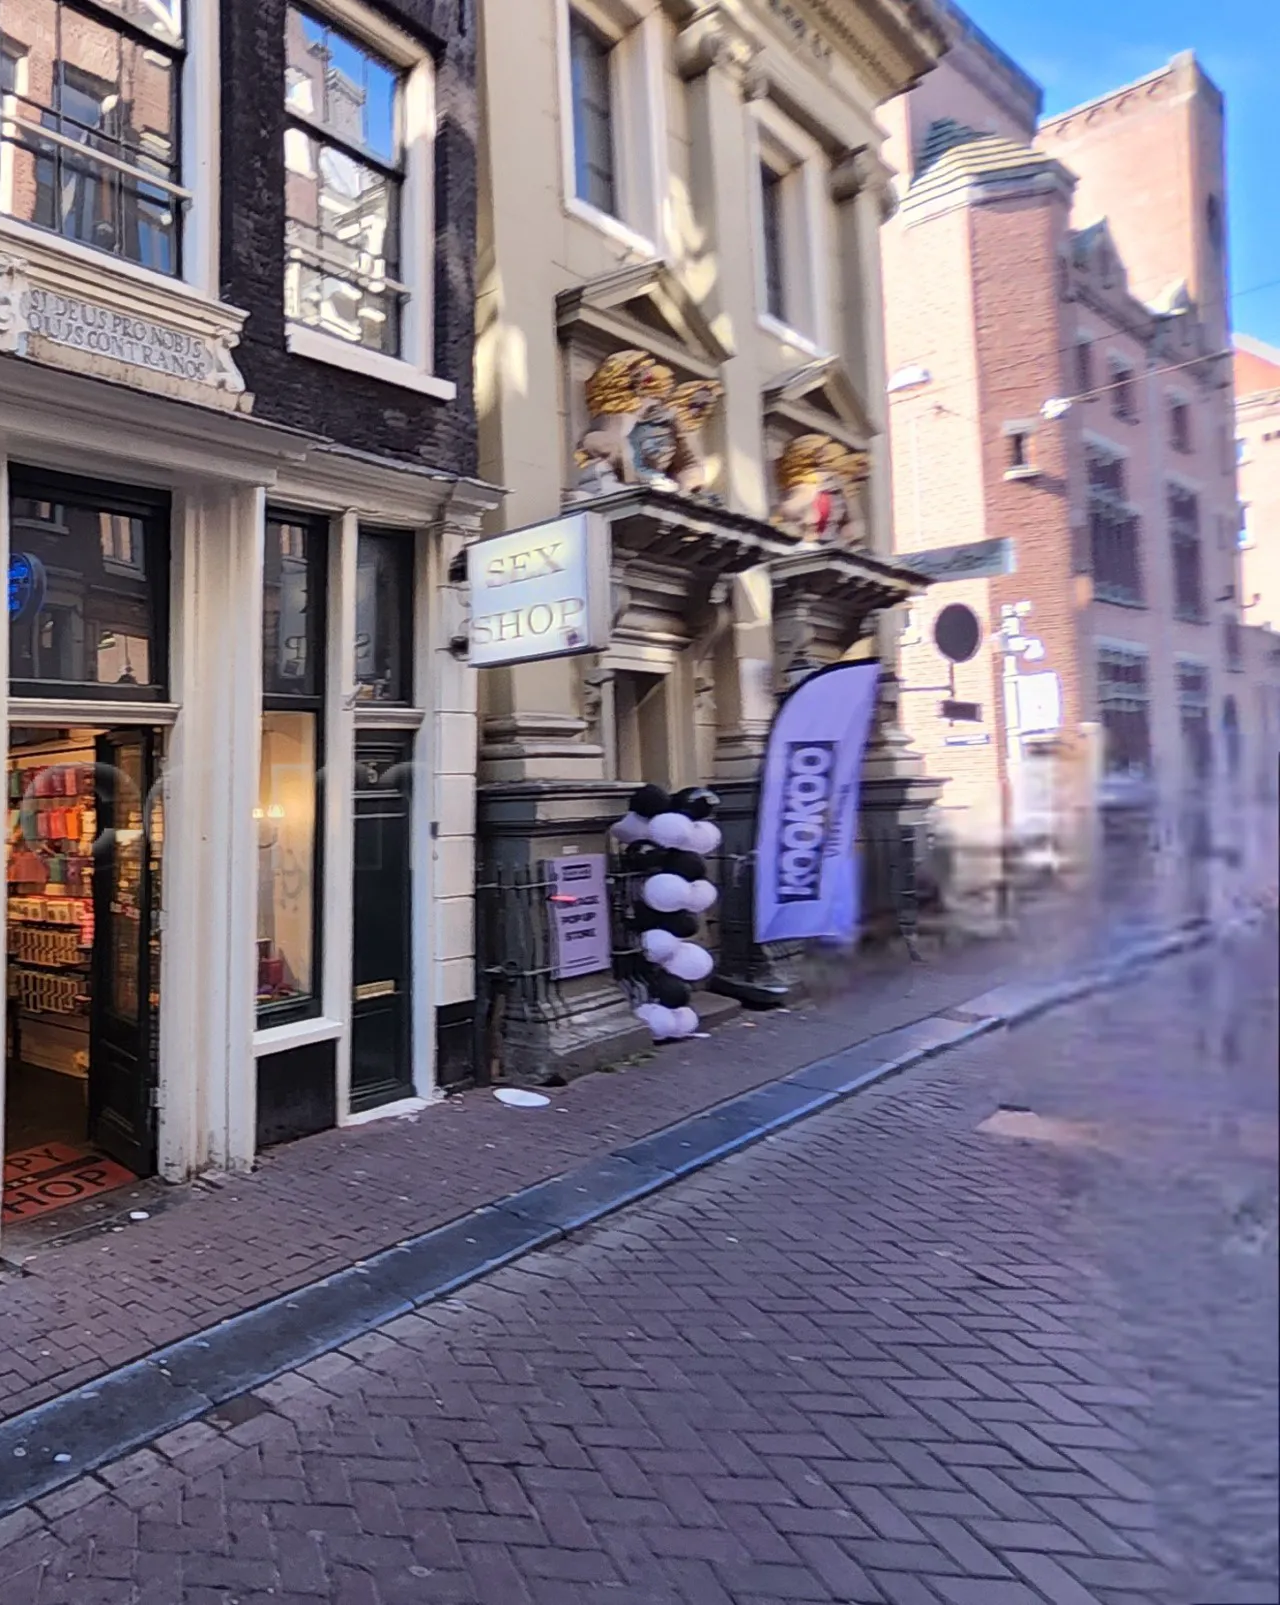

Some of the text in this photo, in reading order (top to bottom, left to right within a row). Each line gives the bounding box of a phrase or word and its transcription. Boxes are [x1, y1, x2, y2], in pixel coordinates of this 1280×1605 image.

[54, 296, 108, 329] DEUS
[111, 313, 147, 341] PRO
[485, 542, 567, 588] SEX
[471, 597, 585, 646] SHOP
[775, 746, 832, 897] KOOKOO
